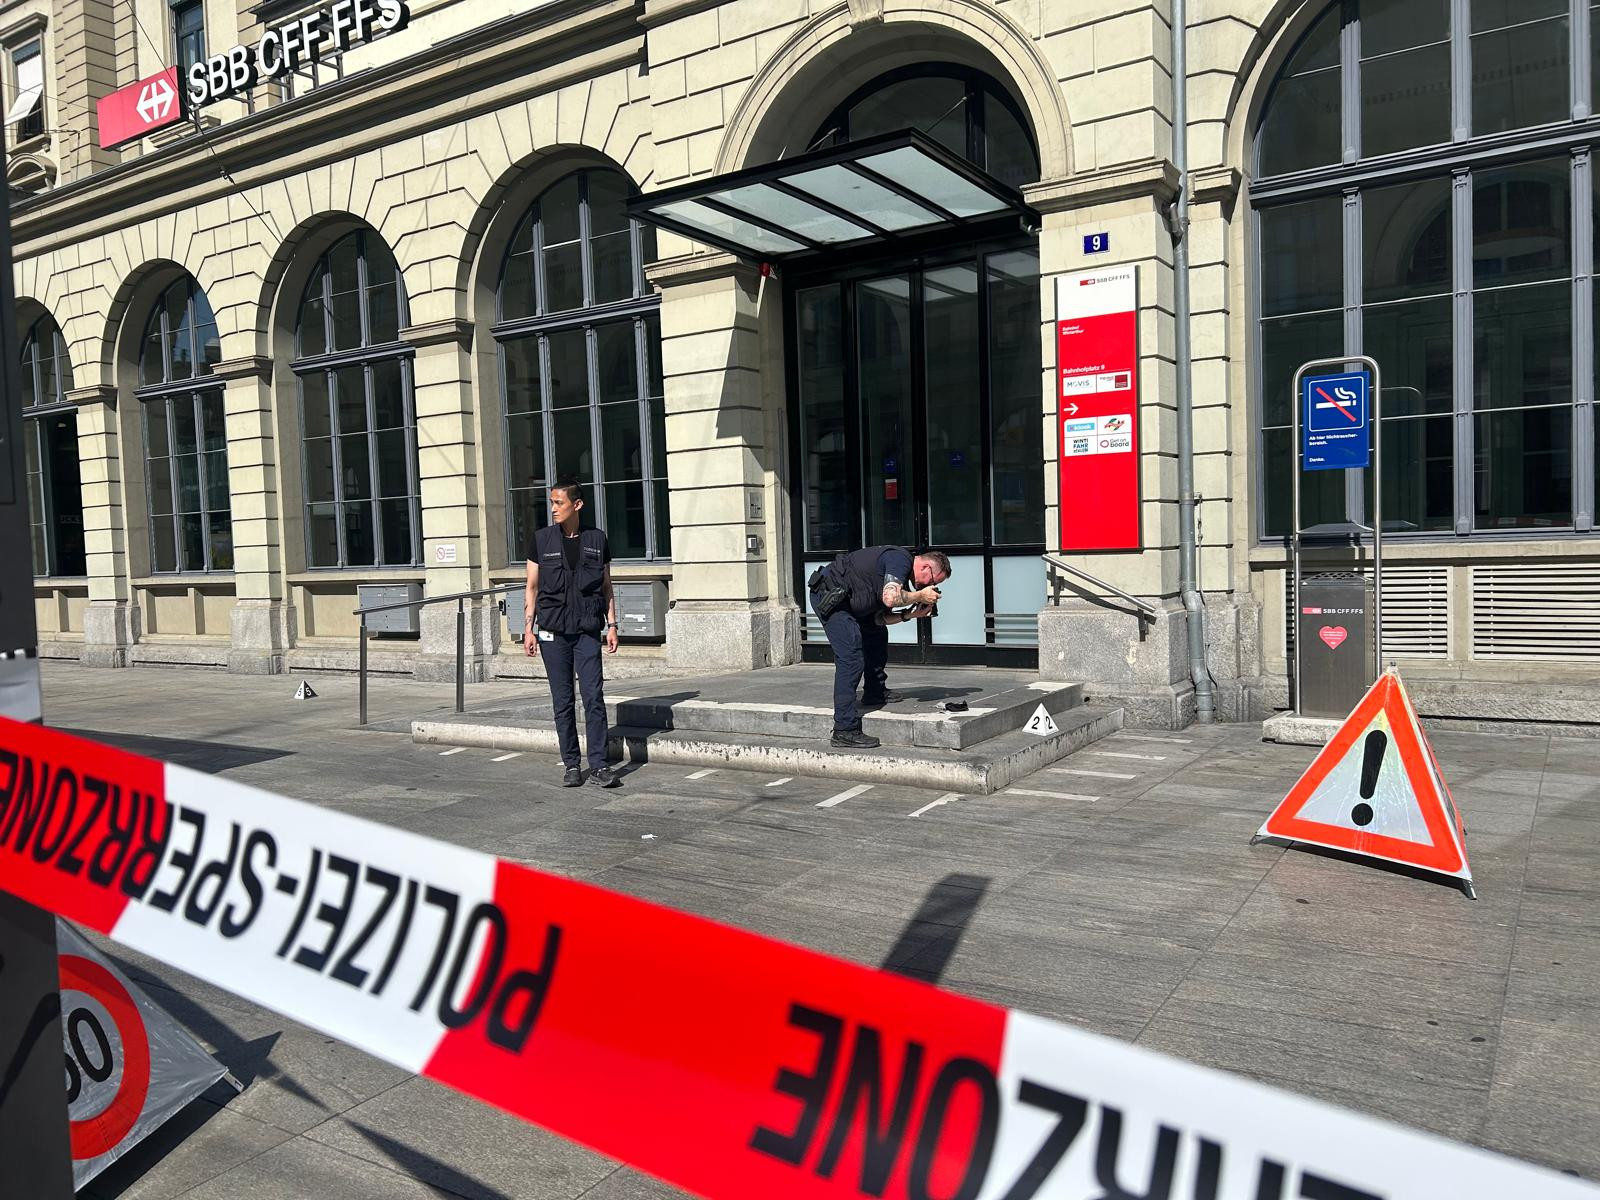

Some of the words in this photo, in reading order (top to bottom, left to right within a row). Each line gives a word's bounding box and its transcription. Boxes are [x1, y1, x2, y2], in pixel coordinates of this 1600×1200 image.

[189, 45, 251, 104] SBB
[258, 12, 321, 76] CFF
[331, 0, 402, 51] FFS
[1093, 236, 1100, 250] 9
[1063, 366, 1100, 374] Bahnhofplatz
[305, 687, 311, 696] 5
[1032, 716, 1040, 729] 2
[1046, 716, 1053, 729] 2
